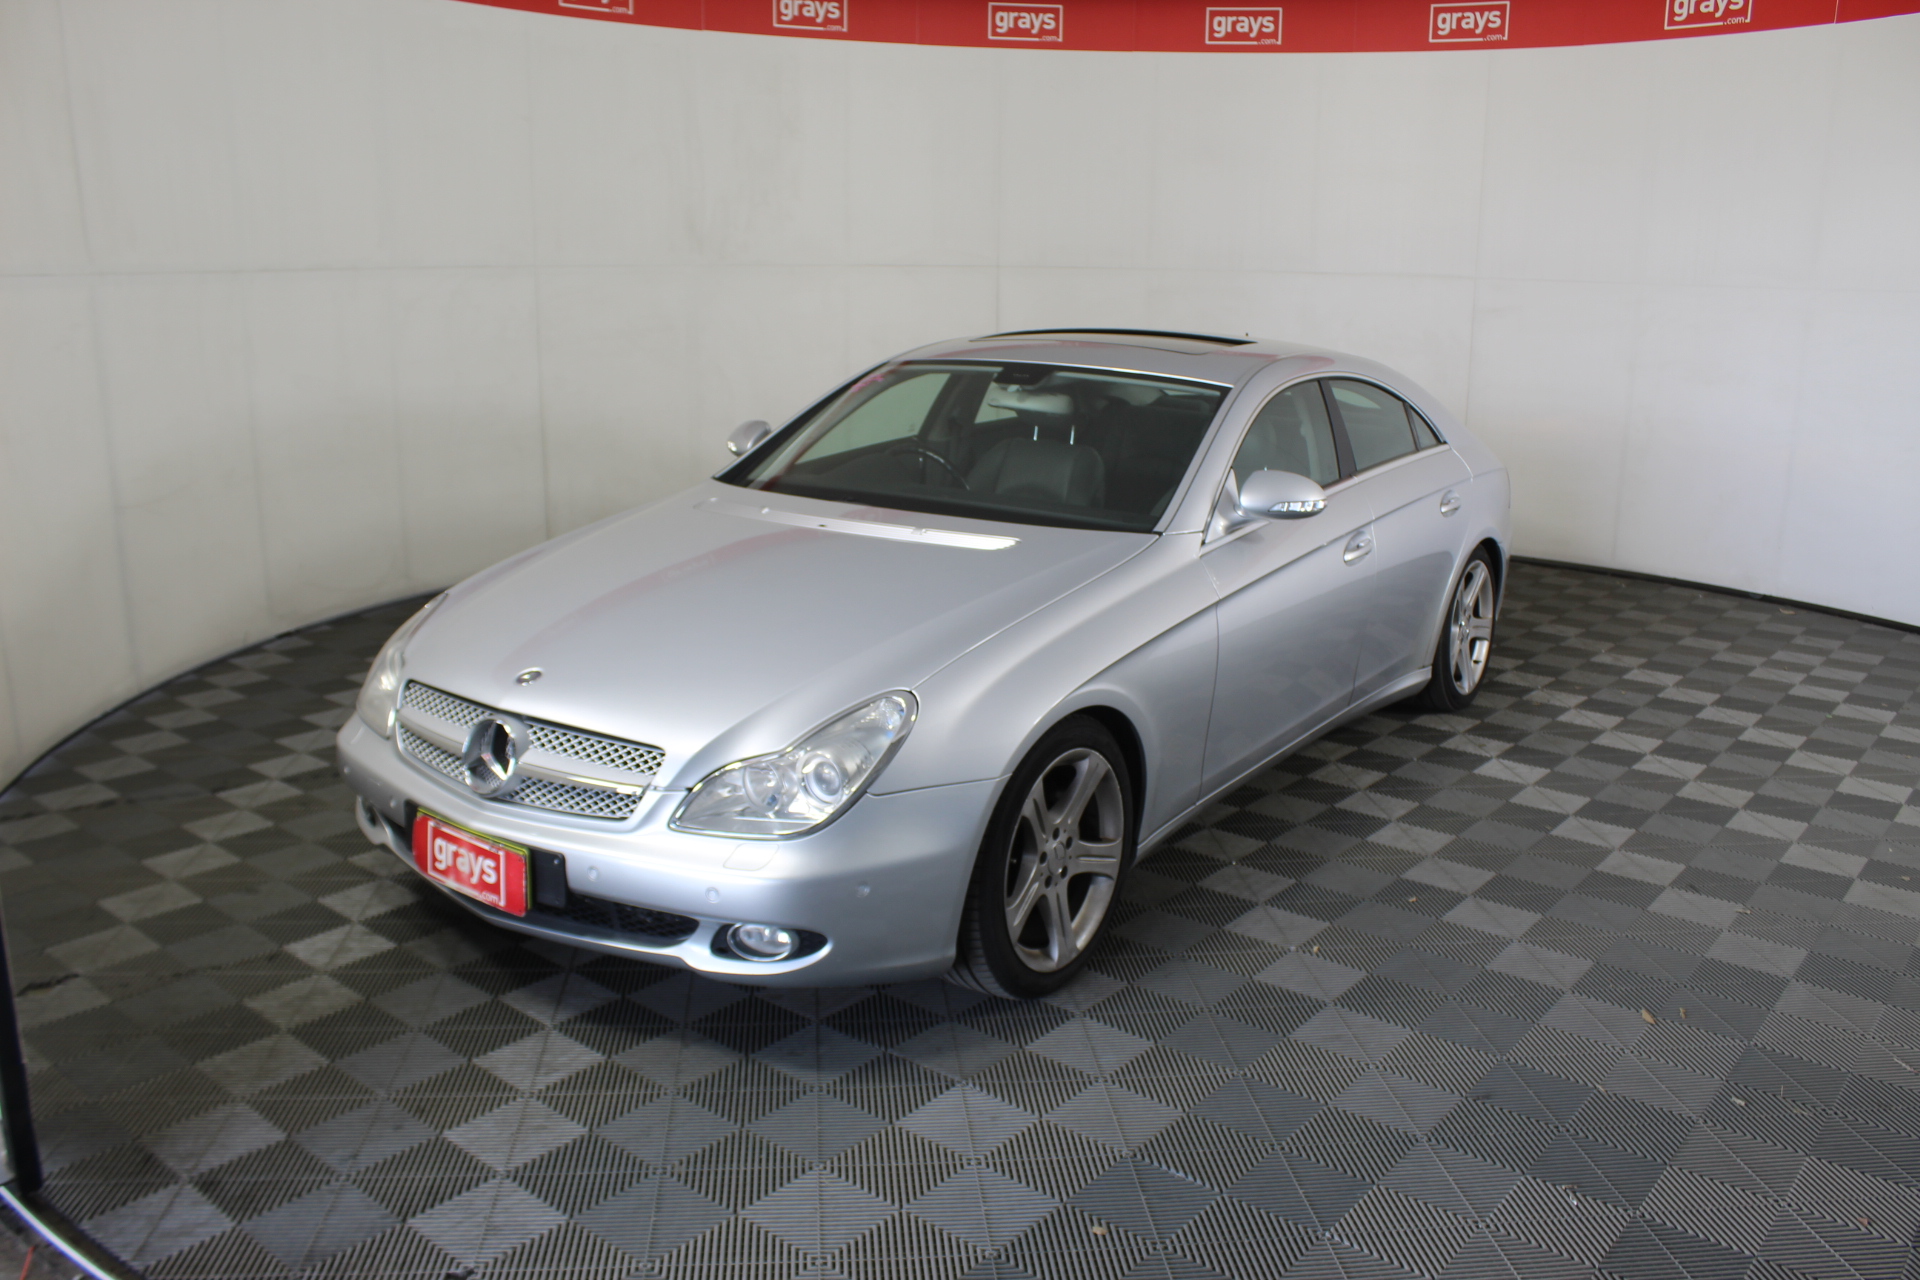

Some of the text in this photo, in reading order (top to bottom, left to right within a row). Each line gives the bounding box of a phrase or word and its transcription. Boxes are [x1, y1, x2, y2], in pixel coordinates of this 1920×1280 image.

[780, 0, 841, 23] grays
[1673, 0, 1744, 21] grays
[1724, 16, 1745, 25] .com
[995, 11, 1056, 34] grays
[1213, 16, 1275, 38] grays
[1437, 11, 1502, 35] grays
[433, 837, 498, 885] grays
